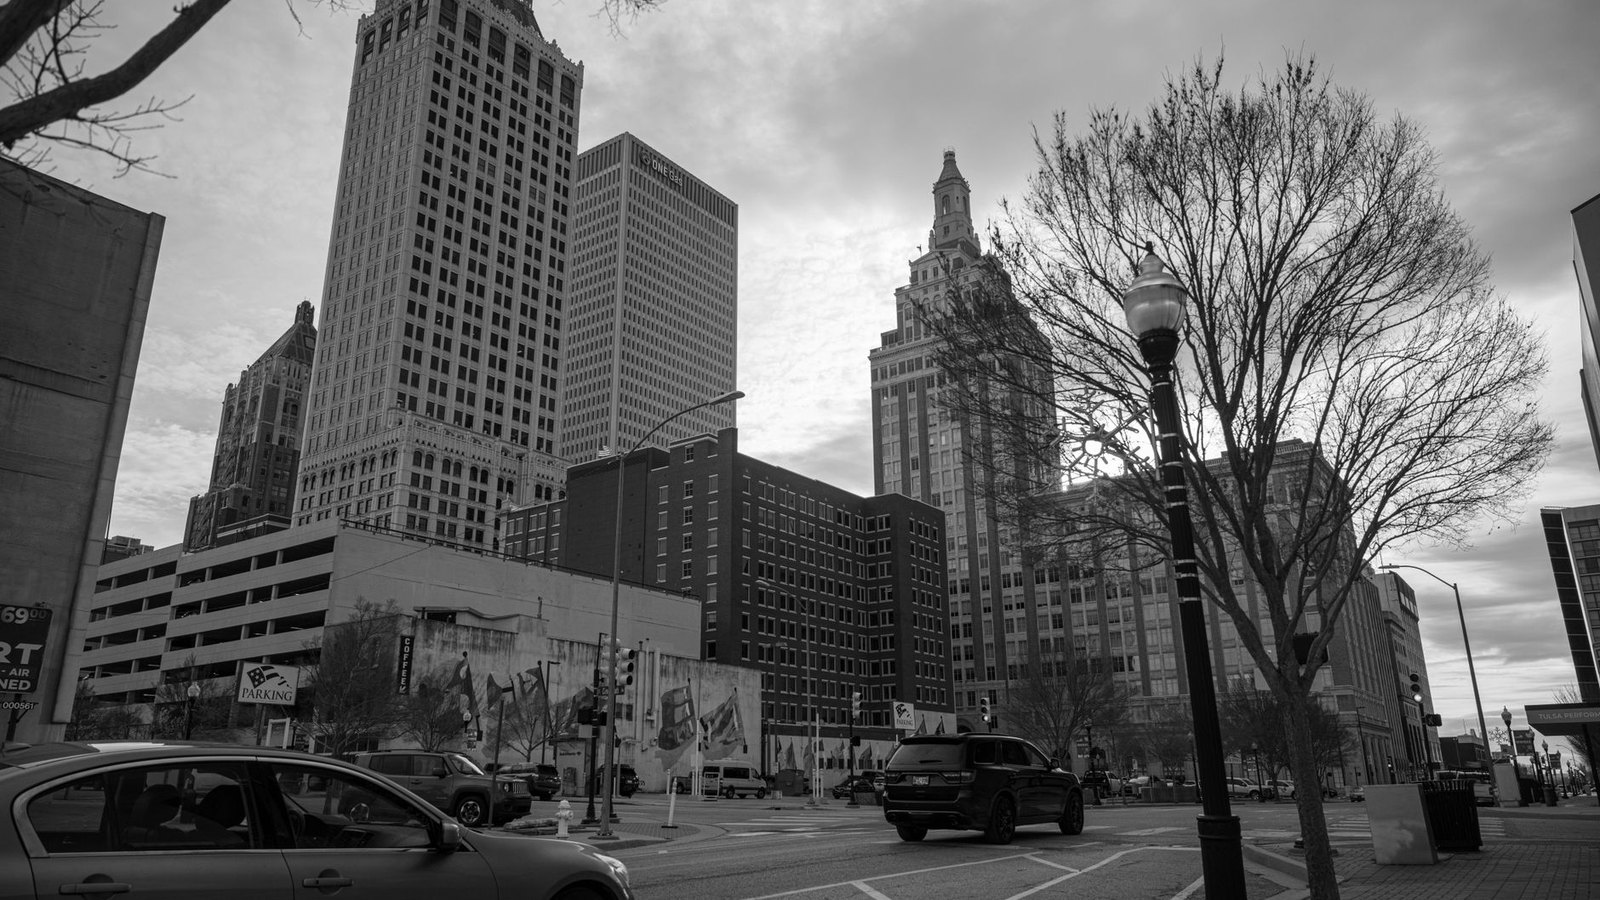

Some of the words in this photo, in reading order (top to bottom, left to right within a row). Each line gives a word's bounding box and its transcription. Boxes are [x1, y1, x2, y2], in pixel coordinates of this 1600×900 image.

[652, 159, 669, 177] ONE
[669, 170, 683, 187] Gas
[400, 637, 411, 686] COFFEE
[9, 667, 31, 678] AIR
[241, 687, 293, 702] PARKING
[2, 701, 35, 710] 000561
[1538, 712, 1563, 720] TULSA
